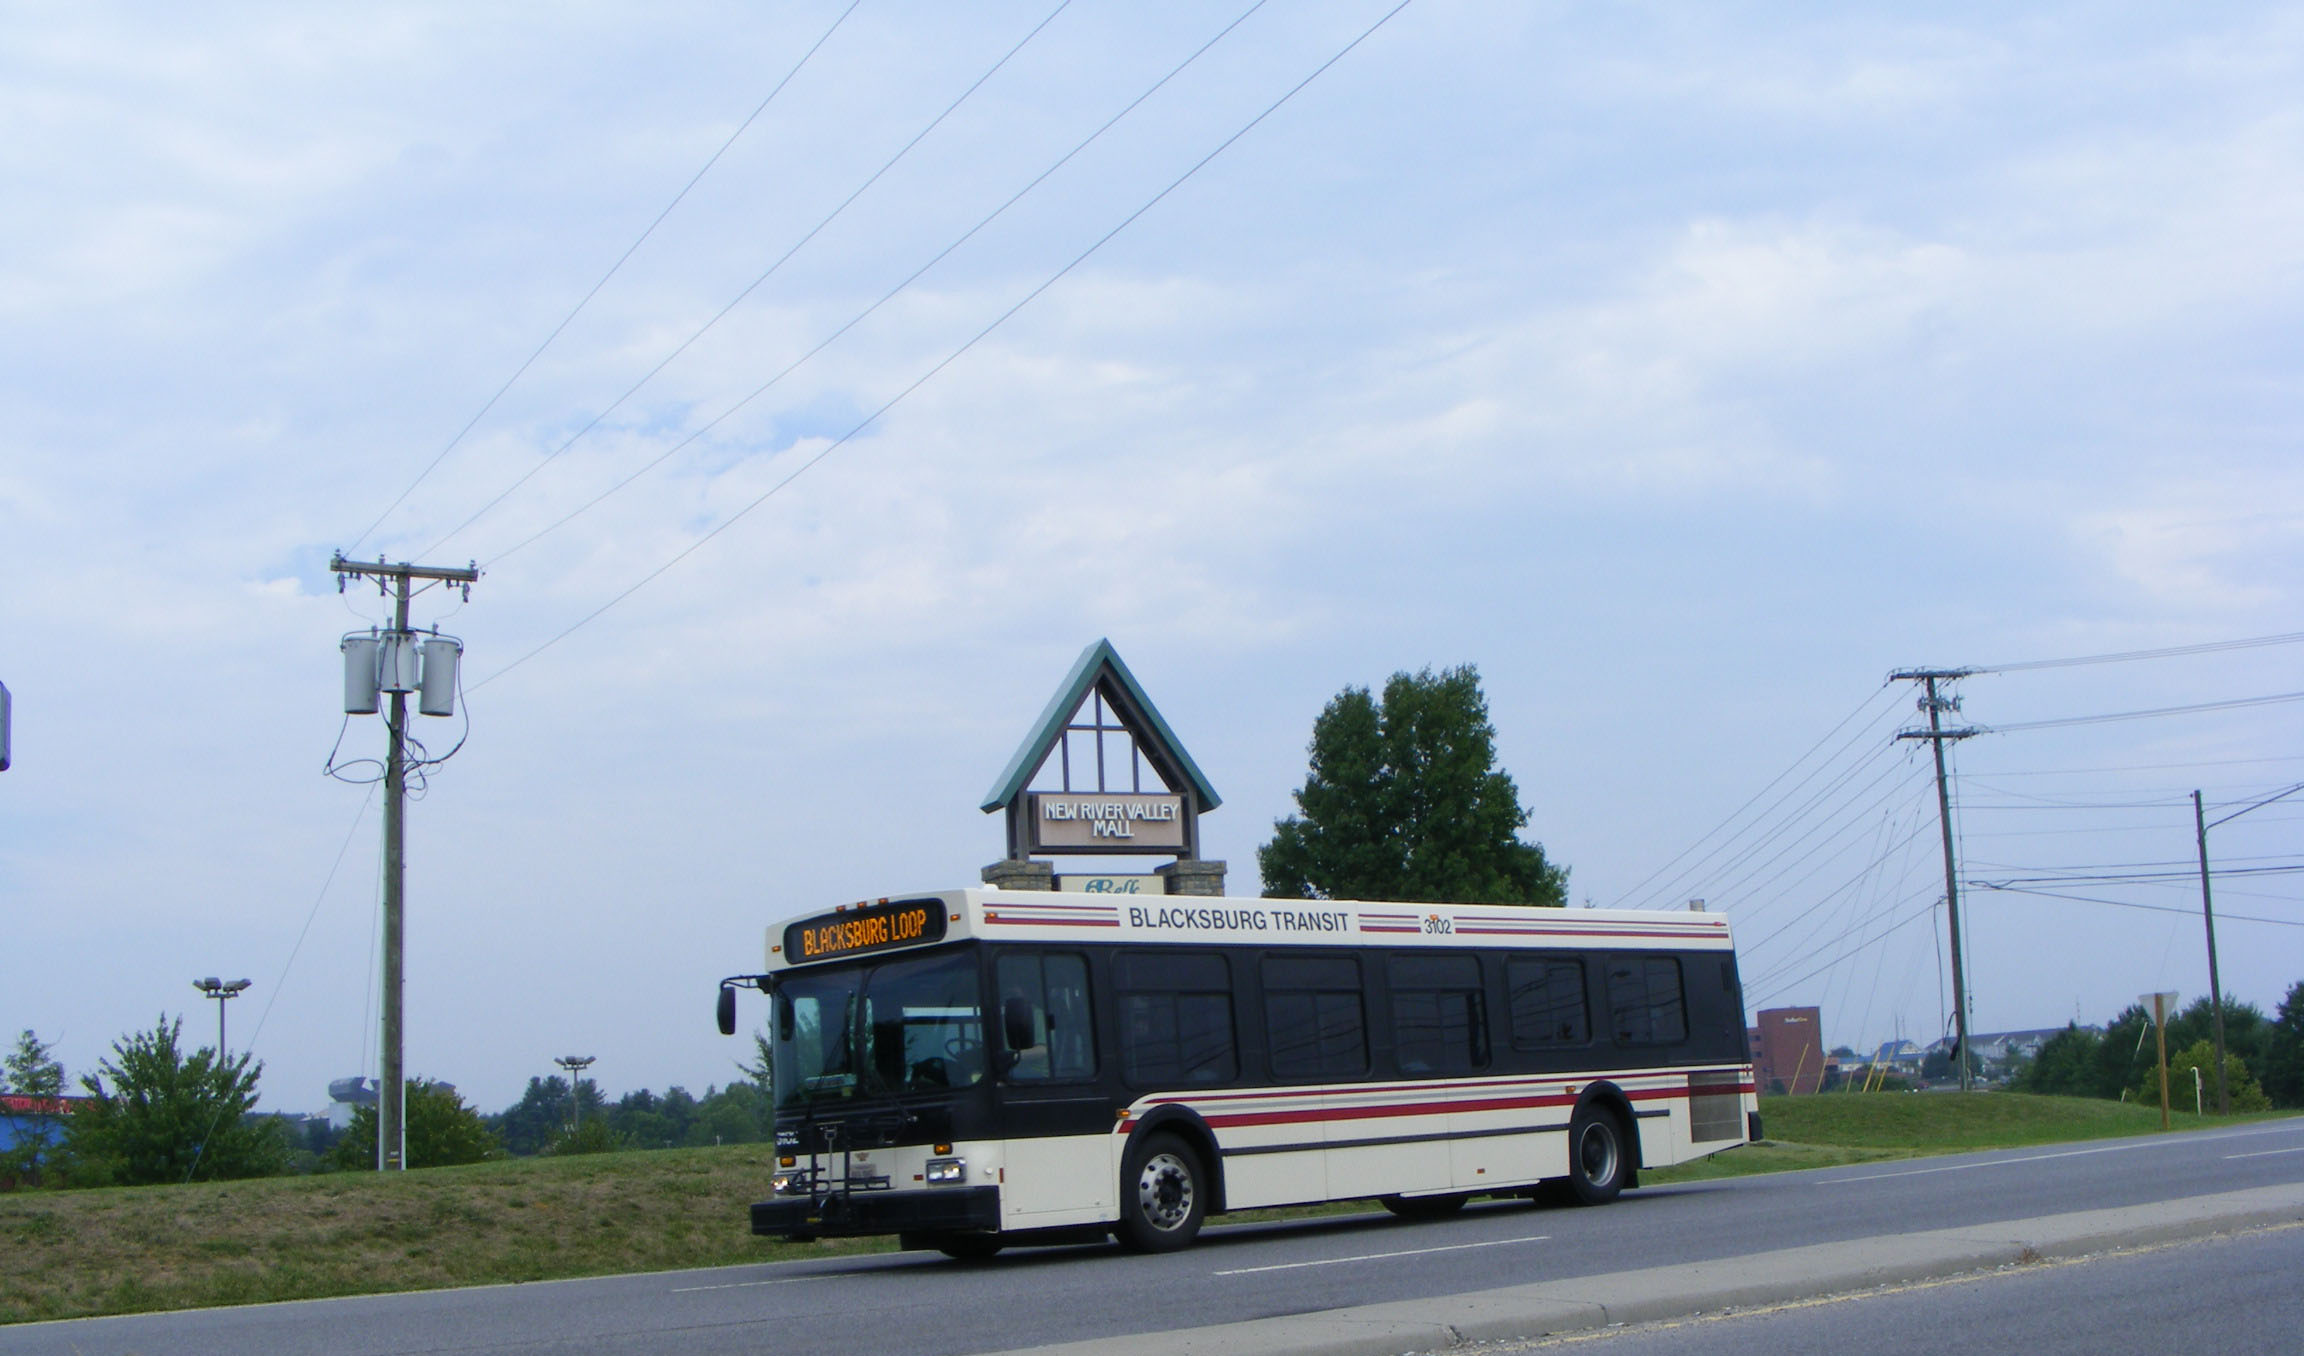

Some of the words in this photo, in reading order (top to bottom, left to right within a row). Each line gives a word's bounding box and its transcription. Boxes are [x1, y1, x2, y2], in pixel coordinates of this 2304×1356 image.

[1045, 802, 1078, 820] NEW
[1080, 802, 1124, 820] RIVER
[1126, 802, 1179, 821] VALLEY
[1092, 820, 1135, 838] MALL
[1128, 907, 1266, 931] BLACKSBURG
[1270, 911, 1348, 932] TRANSIT
[1424, 918, 1452, 934] 3102
[803, 916, 888, 956] BLACKSBURG
[891, 909, 927, 940] LOOP
